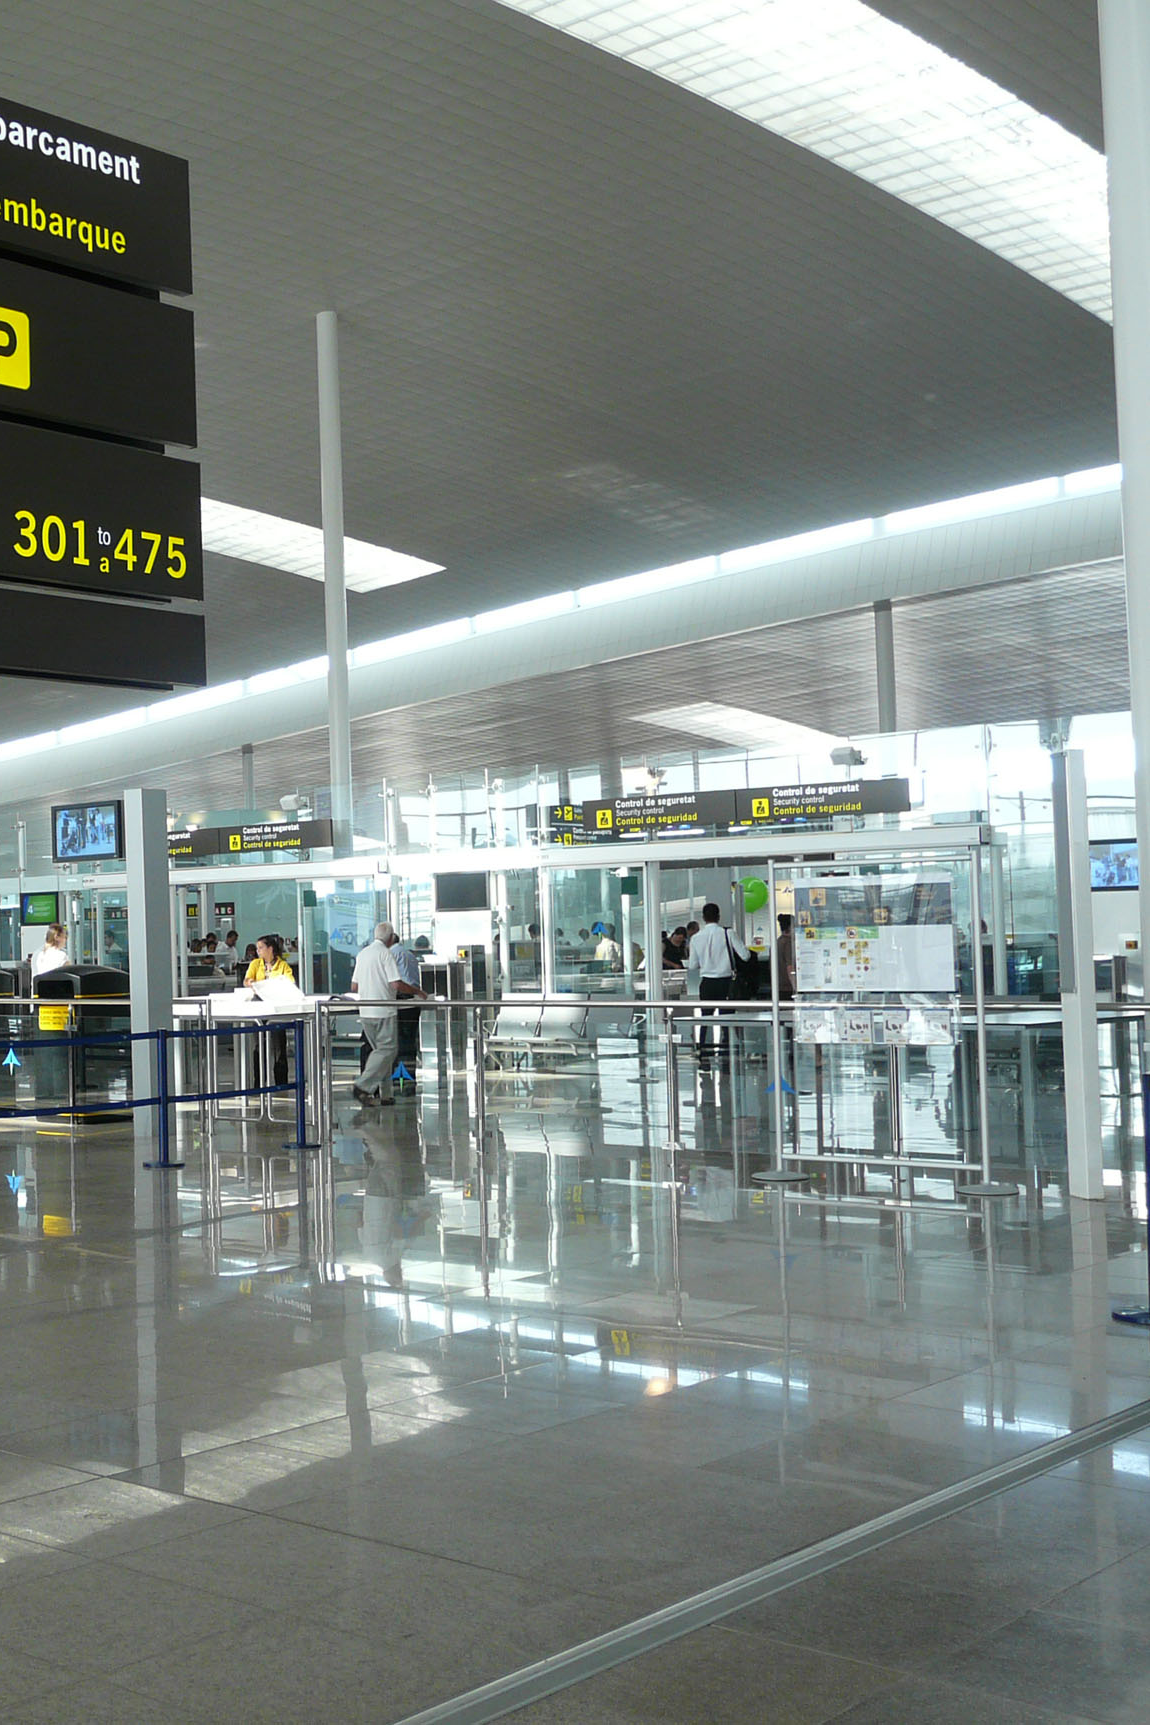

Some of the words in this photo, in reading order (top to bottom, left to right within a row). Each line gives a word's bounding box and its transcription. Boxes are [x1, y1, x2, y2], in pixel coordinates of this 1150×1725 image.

[14, 511, 89, 565] 301
[97, 526, 111, 545] to
[114, 529, 186, 578] 475
[99, 556, 110, 573] a
[772, 787, 803, 797] Control
[805, 786, 816, 795] de
[818, 784, 859, 795] seguretat
[615, 798, 643, 809] Control
[645, 798, 655, 807] de
[658, 796, 695, 806] seguretat
[773, 797, 800, 806] Security
[801, 795, 825, 804] control
[616, 808, 640, 817] Security
[642, 806, 664, 815] control
[773, 805, 803, 816] Control
[806, 804, 816, 814] de
[819, 802, 861, 813] seguridad
[616, 815, 644, 826] Control
[646, 814, 656, 824] de
[658, 812, 698, 823] seguridad
